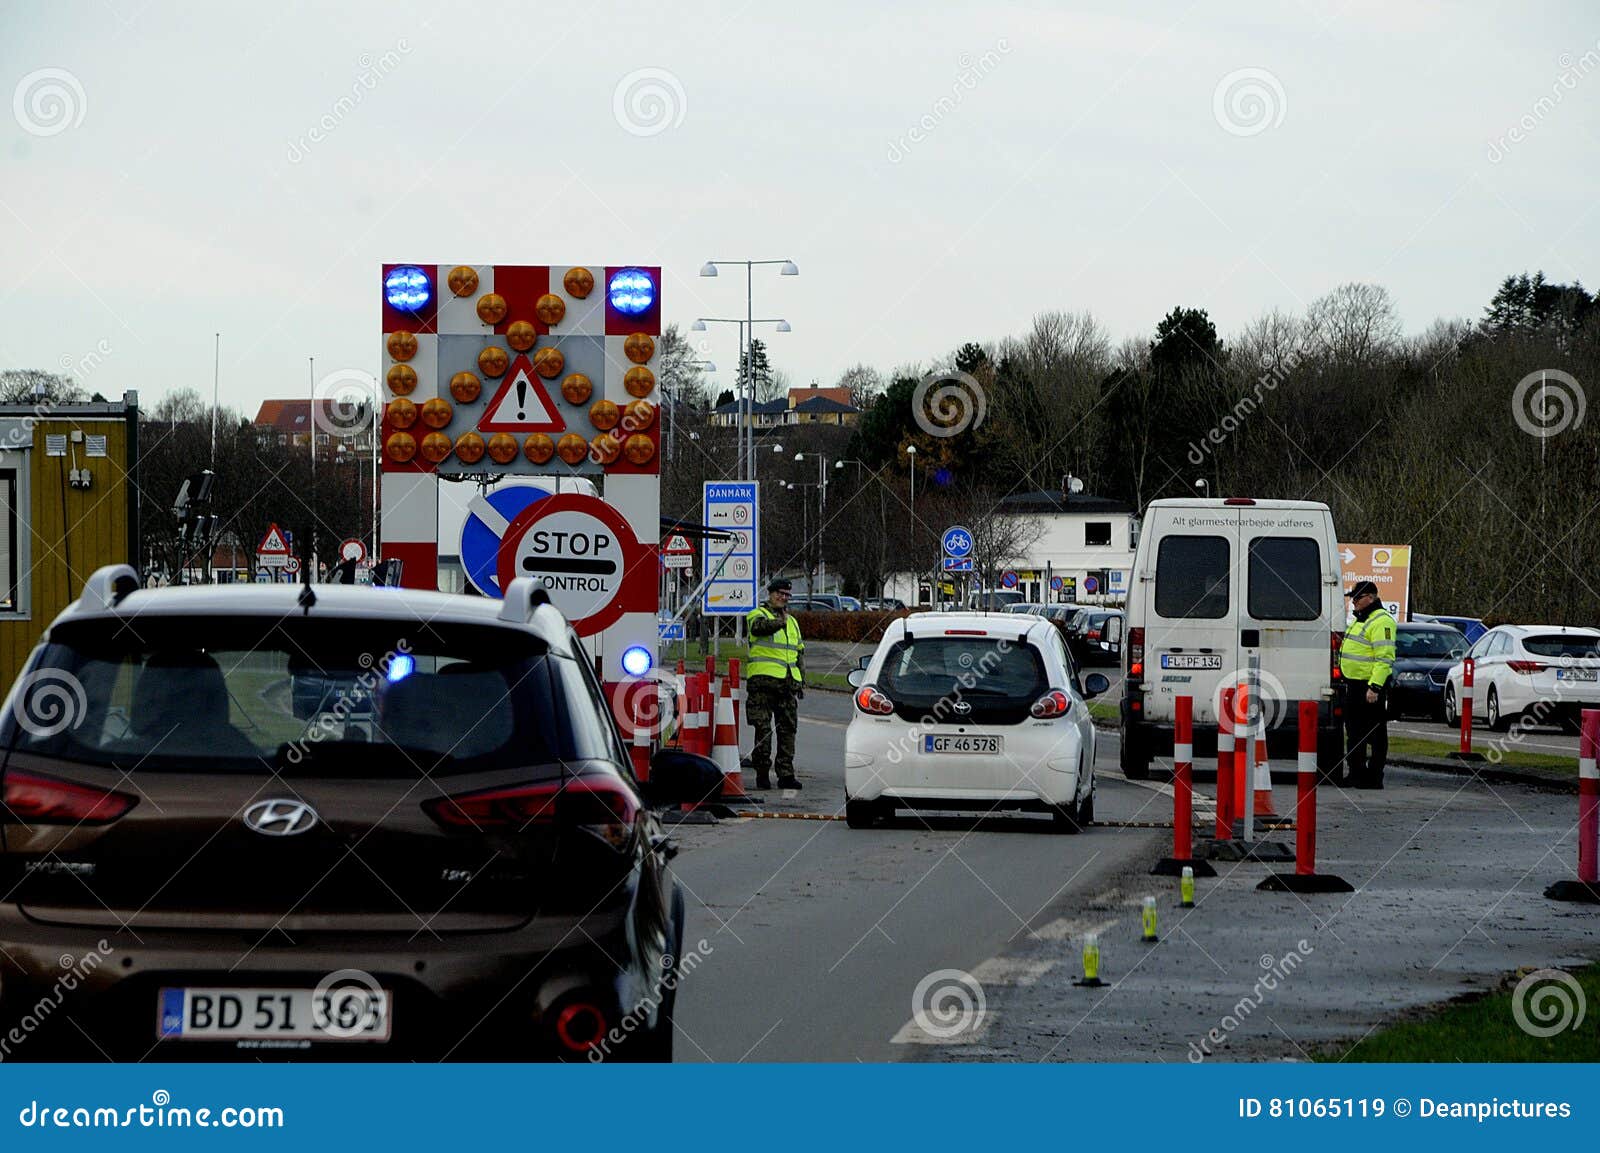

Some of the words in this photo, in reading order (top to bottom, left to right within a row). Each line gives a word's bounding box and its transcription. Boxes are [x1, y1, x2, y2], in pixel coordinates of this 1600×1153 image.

[709, 488, 752, 498] DANMARK
[735, 510, 745, 519] 50
[1172, 517, 1185, 526] Alt
[1277, 518, 1315, 528] udføres
[532, 531, 610, 556] STOP
[286, 561, 298, 569] 50
[735, 563, 746, 572] 130
[536, 575, 609, 592] ONTROL
[1167, 657, 1181, 667] FL
[1187, 657, 1199, 667] PF
[1202, 657, 1220, 667] 134
[934, 738, 951, 751] GF
[955, 738, 970, 751] 46
[973, 739, 997, 752] 578
[190, 996, 243, 1029] BD
[255, 996, 295, 1030] 51
[313, 996, 382, 1031] 365
